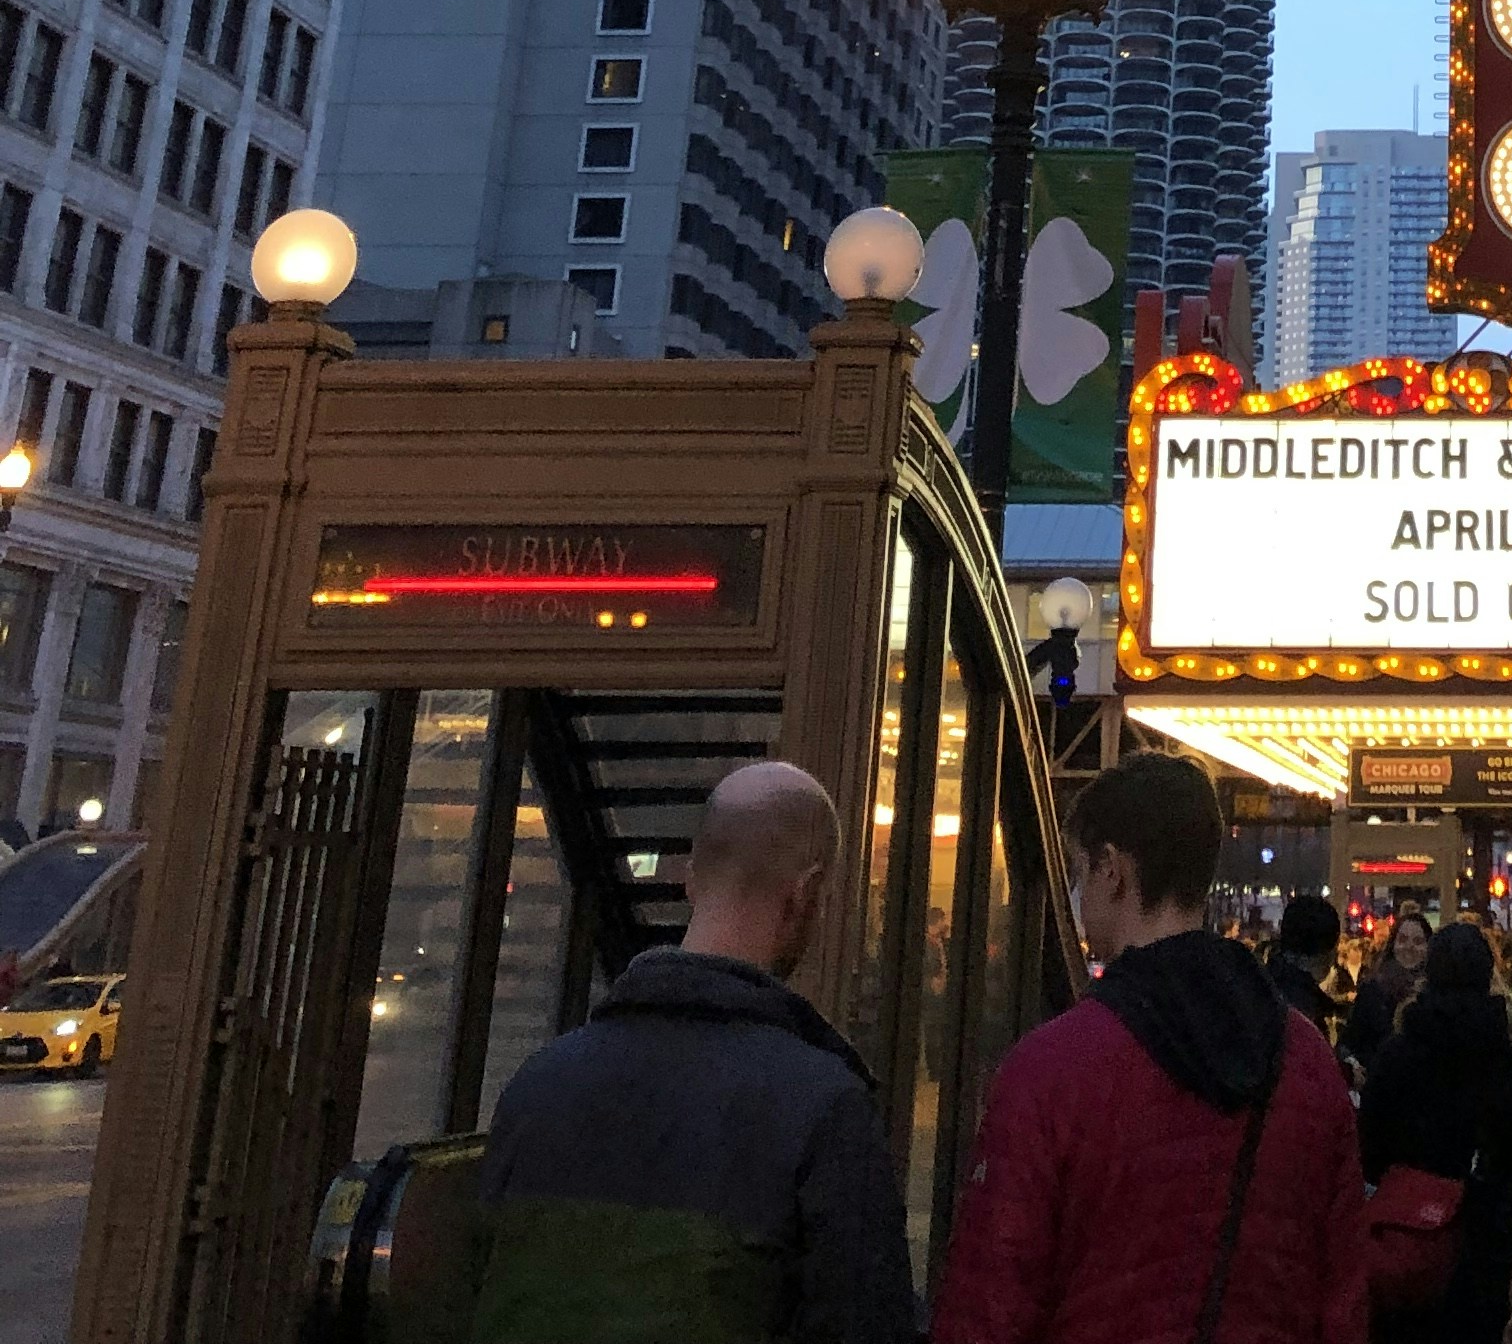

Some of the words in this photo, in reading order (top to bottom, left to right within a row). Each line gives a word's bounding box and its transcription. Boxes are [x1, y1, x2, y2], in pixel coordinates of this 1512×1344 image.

[1165, 438, 1468, 480] MIDDLEDITCH
[458, 536, 634, 576] SUBWAY
[1363, 580, 1480, 624] SOLD
[1371, 764, 1442, 777] CHICAGO
[1477, 771, 1496, 782] THE
[1369, 784, 1416, 796] MARQUEE
[1418, 784, 1443, 795] TOUR
